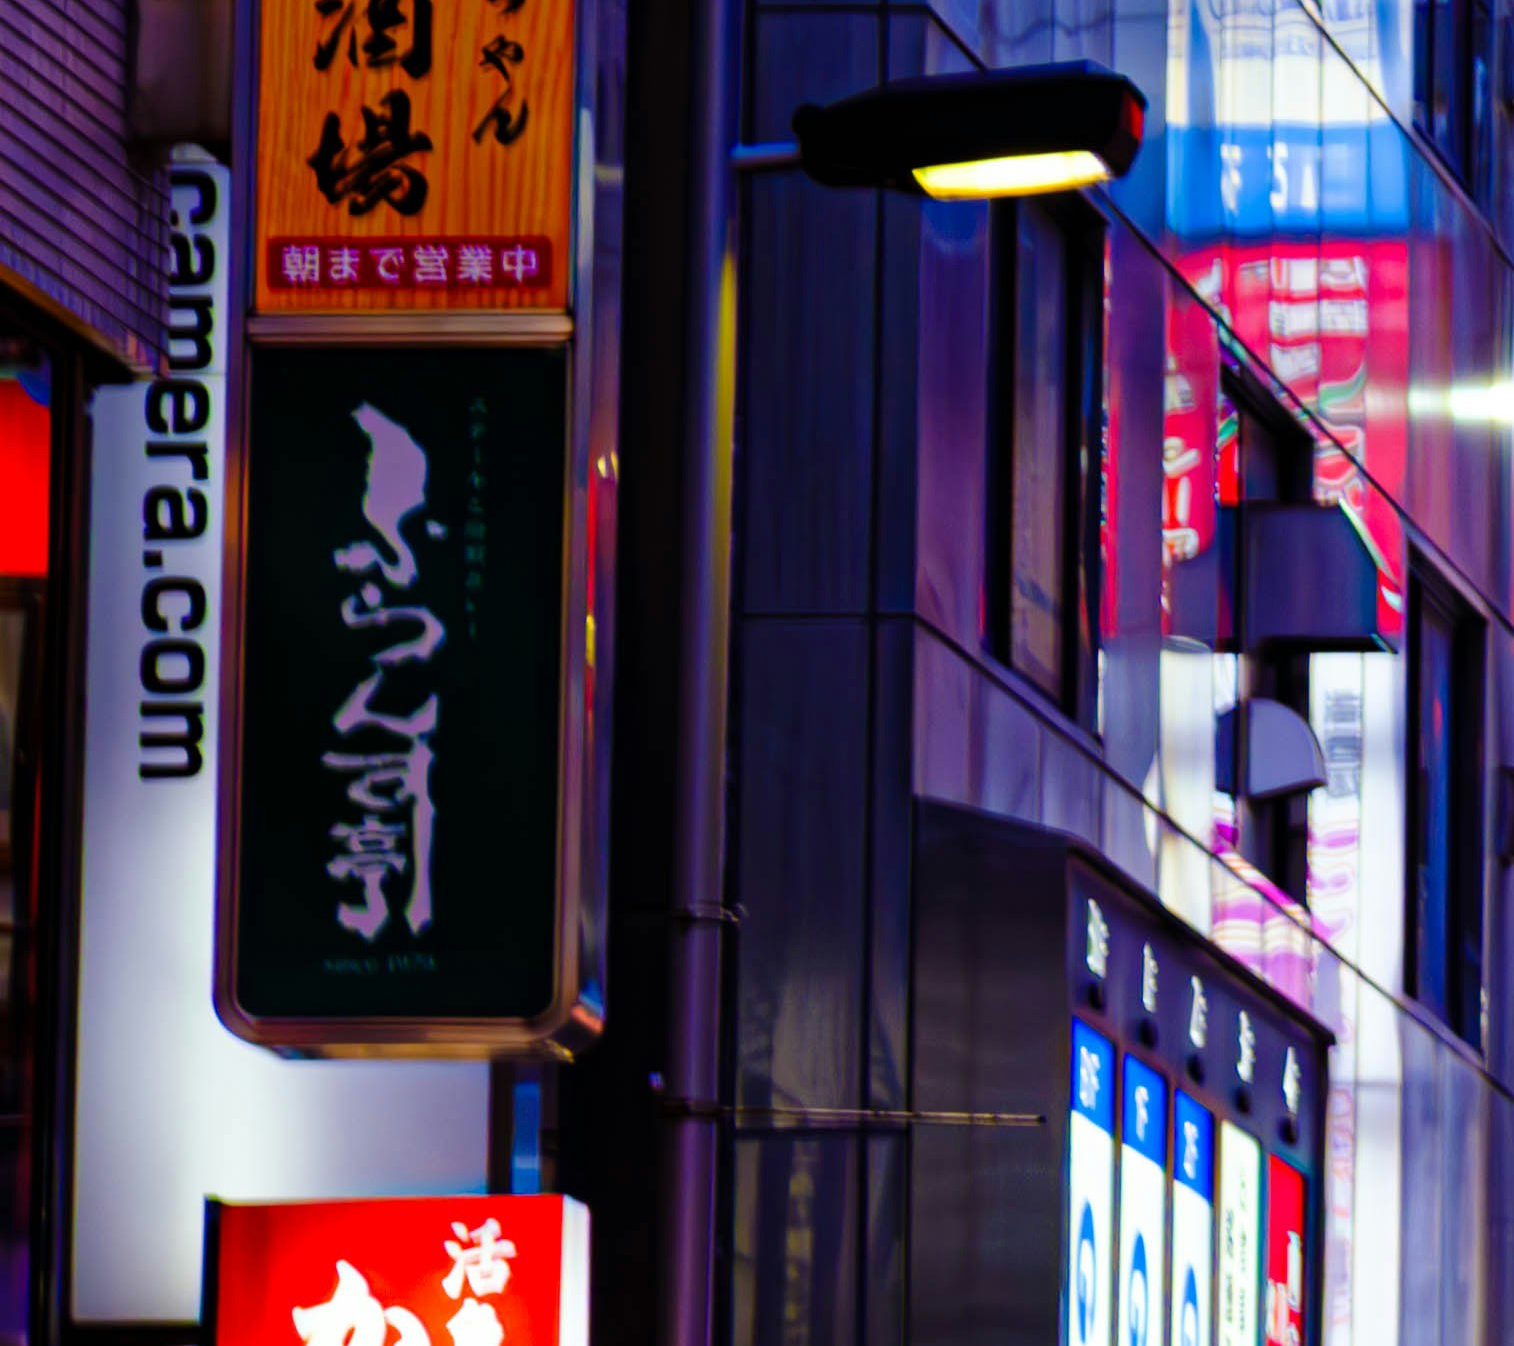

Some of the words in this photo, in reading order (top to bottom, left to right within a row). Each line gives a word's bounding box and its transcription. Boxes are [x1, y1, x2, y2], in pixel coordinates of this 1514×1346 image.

[281, 246, 539, 285] 朝まで営業中
